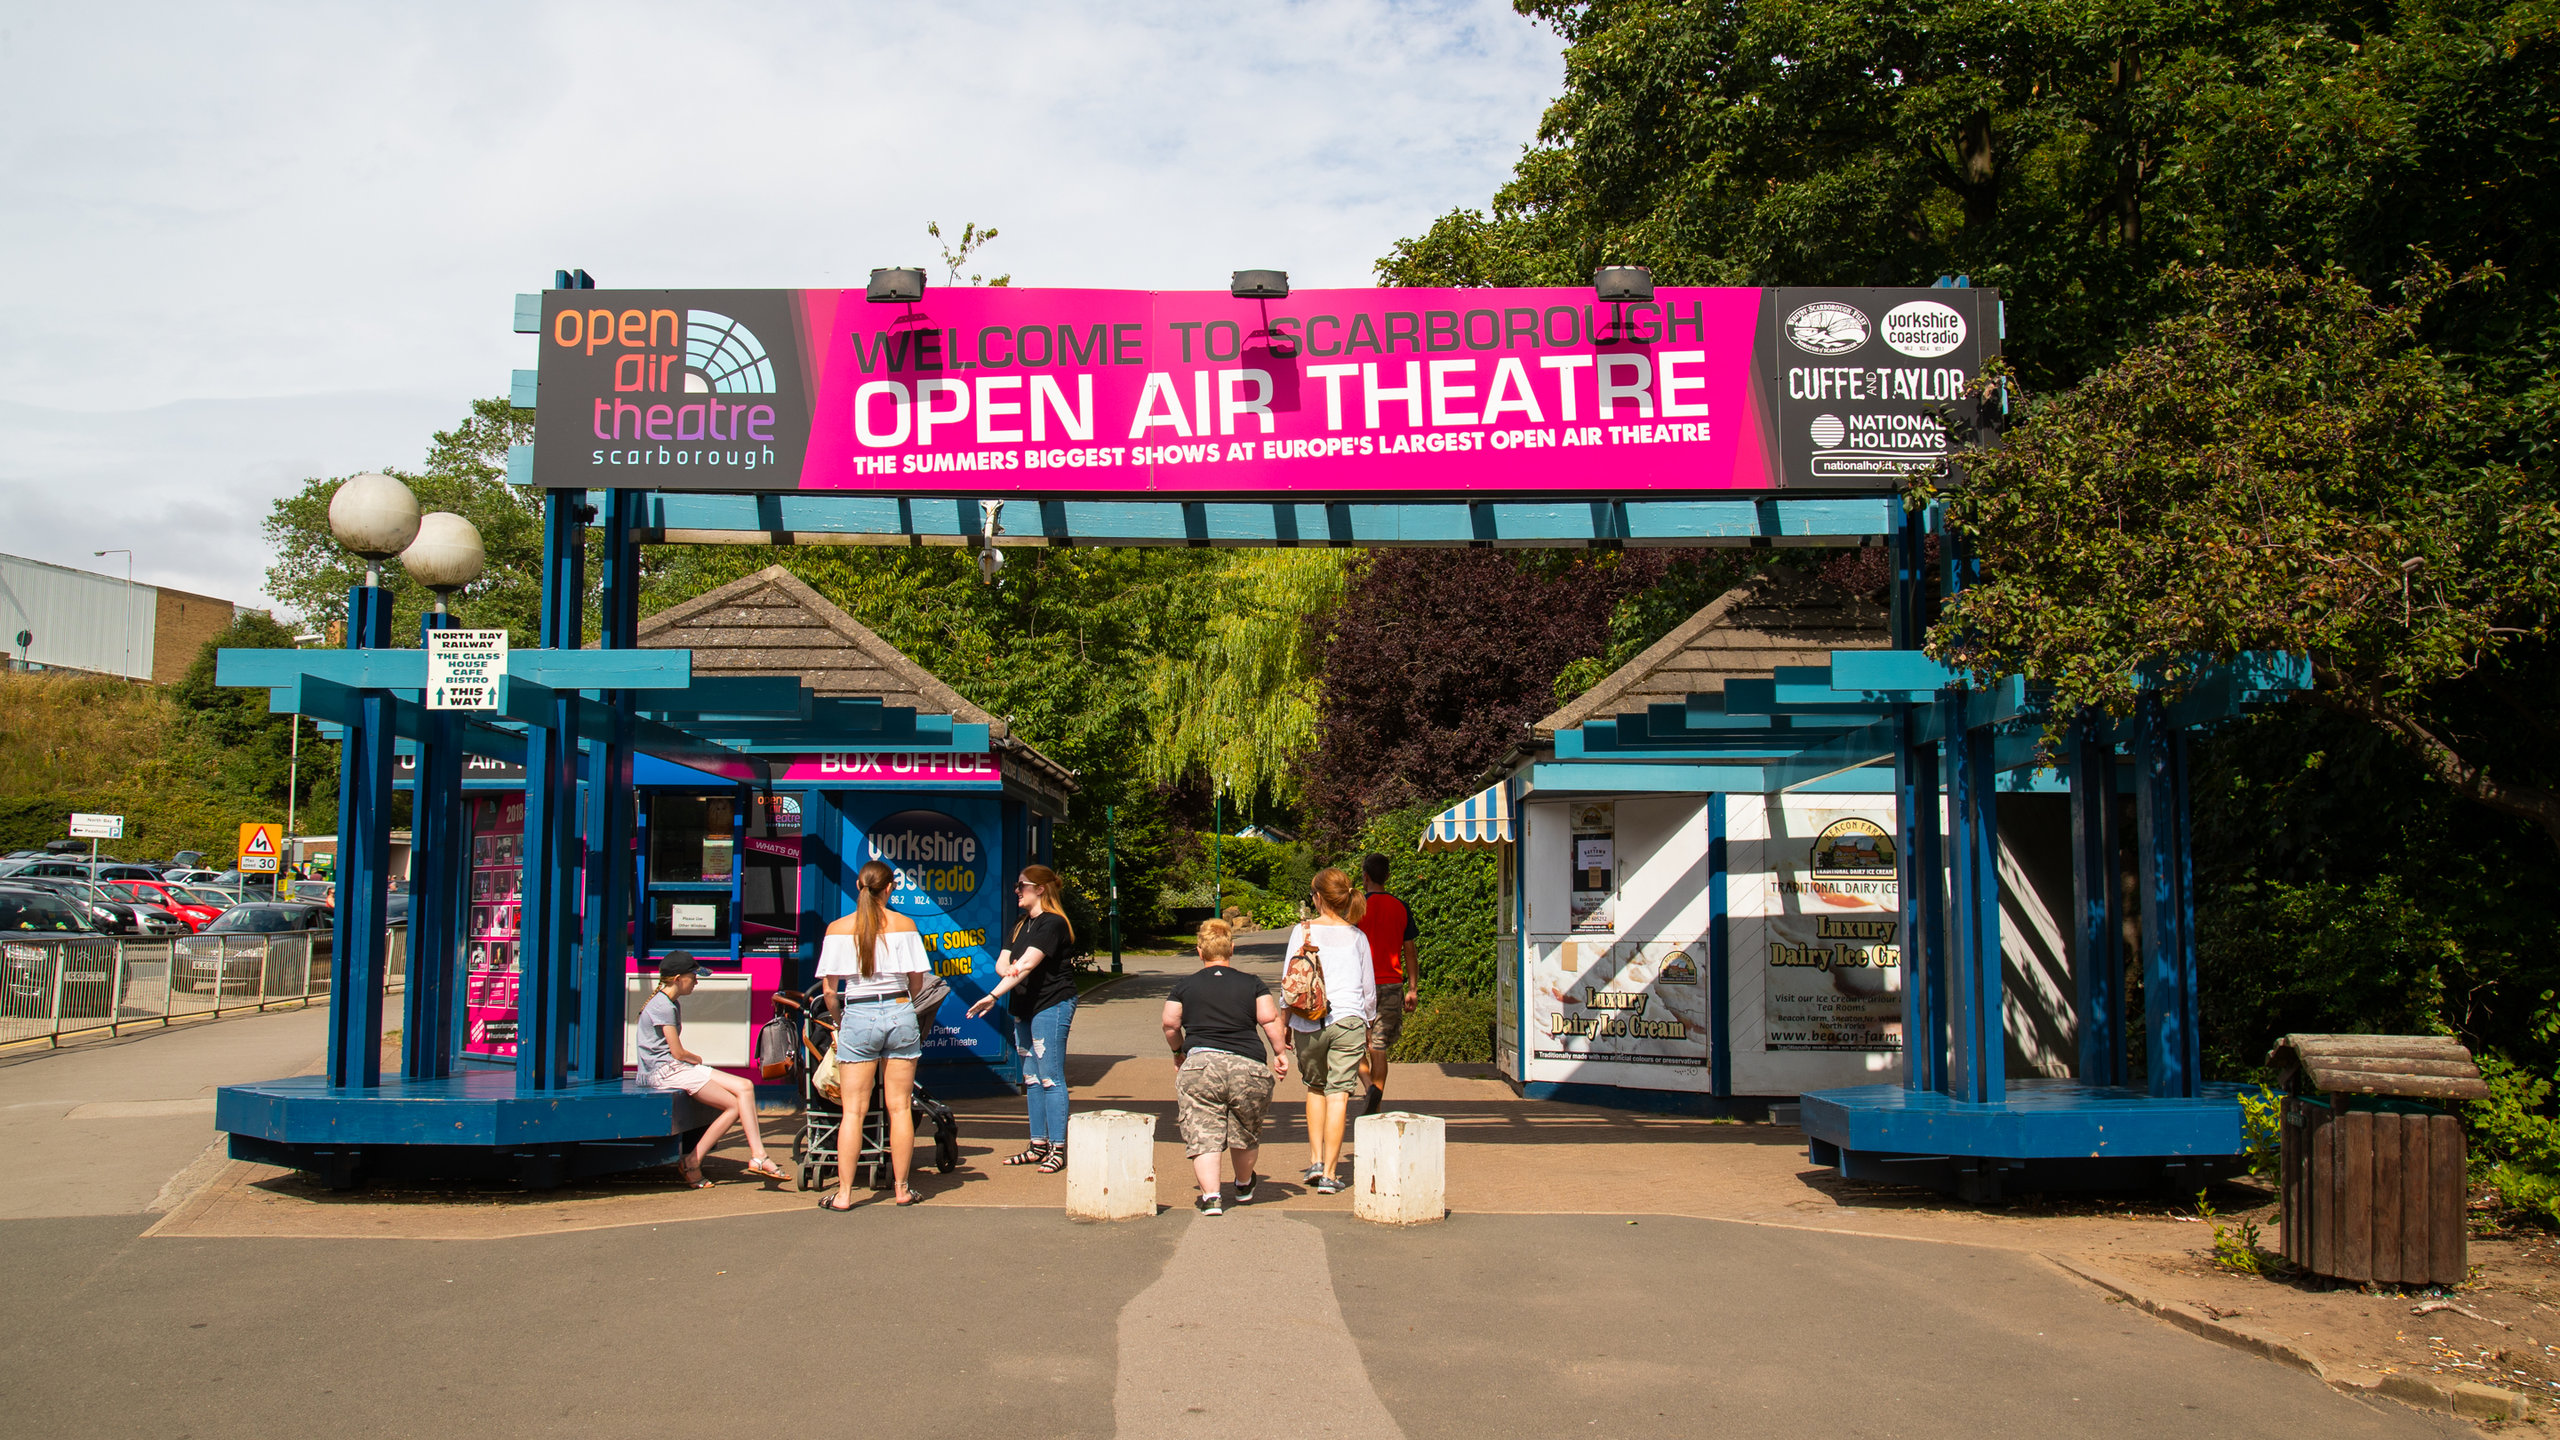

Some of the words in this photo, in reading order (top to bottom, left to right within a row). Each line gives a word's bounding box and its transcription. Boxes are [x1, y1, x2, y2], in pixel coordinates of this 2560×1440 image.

[1808, 304, 1851, 314] SCARBOROUGH
[1888, 312, 1959, 330] yorkshire
[554, 309, 679, 356] open
[850, 323, 1143, 375] WELCOME
[1169, 319, 1241, 363] TO
[1268, 300, 1705, 360] SCARBOROUGH
[1889, 330, 1959, 344] coastradio
[614, 353, 678, 393] air
[1789, 367, 1865, 400] CUFFE
[1866, 371, 1877, 396] AND
[1877, 367, 1967, 400] TAYLOR
[853, 373, 1095, 449] OPEN
[1128, 367, 1275, 440] AIR
[1307, 350, 1710, 431] THEATRE
[594, 397, 776, 441] theatre
[1849, 415, 1947, 431] NATIONAL
[853, 454, 897, 475] THE
[902, 450, 1019, 473] SUMMERS
[1024, 447, 1140, 469] BIGGEST
[1144, 442, 1220, 466] SHOWS
[1227, 441, 1259, 461] AT
[1262, 434, 1374, 459] EUROPE'S
[1378, 430, 1485, 455] LARGEST
[1490, 427, 1557, 450] OPEN
[1561, 426, 1604, 447] AIR
[1607, 421, 1711, 445] THEATRE
[1849, 432, 1947, 449] HOLIDAYS
[592, 444, 775, 470] scarborough
[450, 688, 483, 696] THIS
[450, 698, 482, 706] WAY
[821, 752, 882, 773] BOX
[892, 752, 992, 773] OFFICE
[506, 803, 524, 823] 2018
[1825, 821, 1858, 841] BEACON
[1861, 822, 1884, 841] FARM
[756, 841, 786, 854] WHAT'S
[787, 848, 800, 857] ON
[868, 830, 976, 862] yorkshire
[259, 858, 276, 869] 30
[893, 864, 975, 892] astradio
[1771, 882, 1842, 894] TRADITIONAL
[1845, 882, 1879, 894] DAIRY
[1882, 882, 1899, 894] ICE
[891, 896, 905, 904] 96.2
[914, 896, 930, 904] 102.4
[938, 897, 952, 906] 103.1
[943, 928, 986, 950] SONGS
[1816, 915, 1897, 943] Luxury
[934, 956, 973, 978] LONG!
[1770, 942, 1833, 972] Dairy
[1835, 943, 1869, 967] Ice
[1586, 986, 1649, 1014] Luxury
[1775, 994, 1795, 1003] Visit
[1816, 994, 1829, 1003] Ice
[1817, 1004, 1833, 1012] Tea
[1836, 1004, 1866, 1012] Rooms
[934, 1025, 961, 1034] Partner
[1551, 1012, 1599, 1040] Dairy
[1600, 1013, 1626, 1036] Ice
[1628, 1014, 1687, 1039] Cream
[921, 1038, 935, 1048] pen
[937, 1038, 947, 1046] Air
[950, 1037, 978, 1046] Theatre
[1771, 1031, 1902, 1043] www.beacon-farm.
[1539, 1051, 1571, 1060] Traditionally
[1662, 1057, 1701, 1065] preservatives
